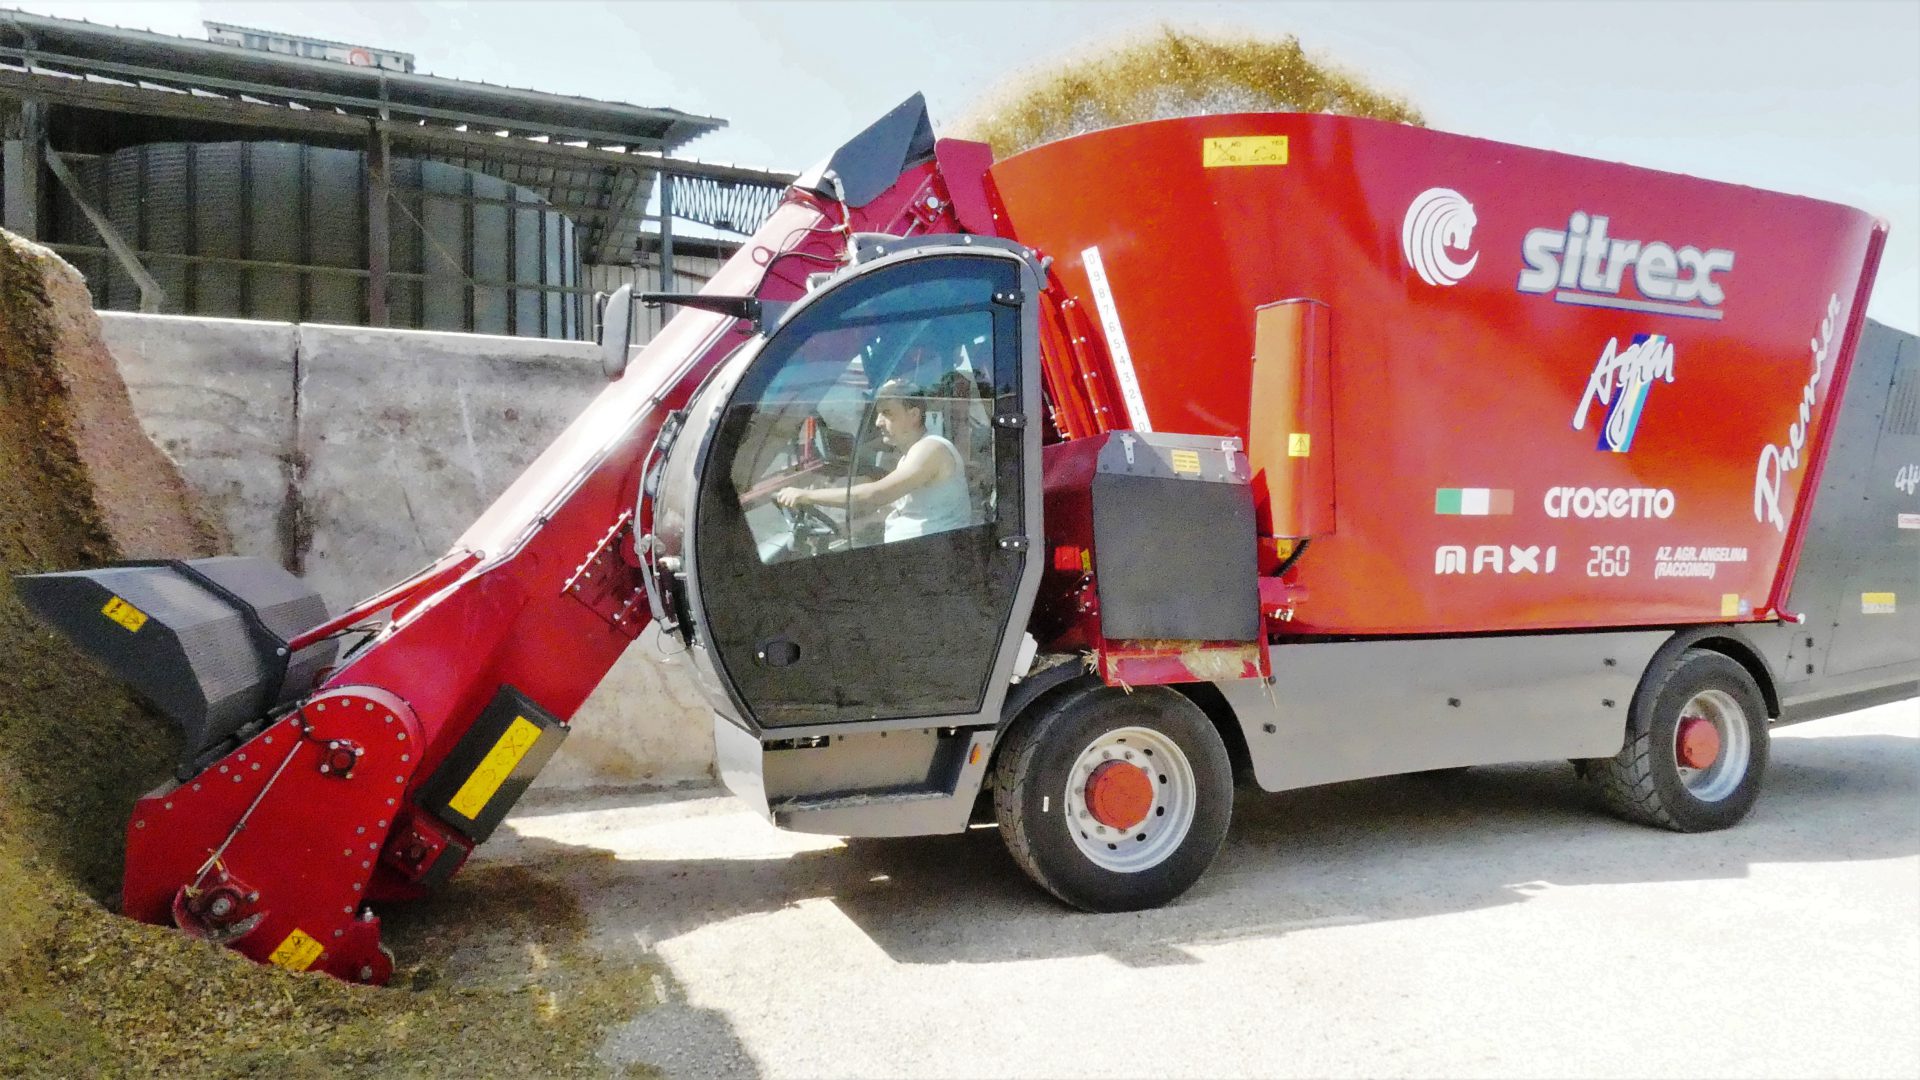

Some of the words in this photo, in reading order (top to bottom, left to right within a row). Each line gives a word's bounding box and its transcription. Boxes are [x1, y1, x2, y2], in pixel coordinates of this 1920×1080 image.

[1516, 210, 1735, 306] sitrex
[1093, 271, 1101, 282] 9
[1098, 288, 1106, 299] 8
[1103, 304, 1109, 315] 7
[1108, 322, 1116, 333] 6
[1113, 338, 1121, 349] 5
[1119, 355, 1126, 367] 4
[1124, 372, 1131, 383] 3
[1129, 388, 1137, 399] 2
[1134, 406, 1140, 416] 1
[1754, 293, 1841, 532] Premier
[1435, 545, 1557, 575] MAXI
[1586, 545, 1631, 577] 260
